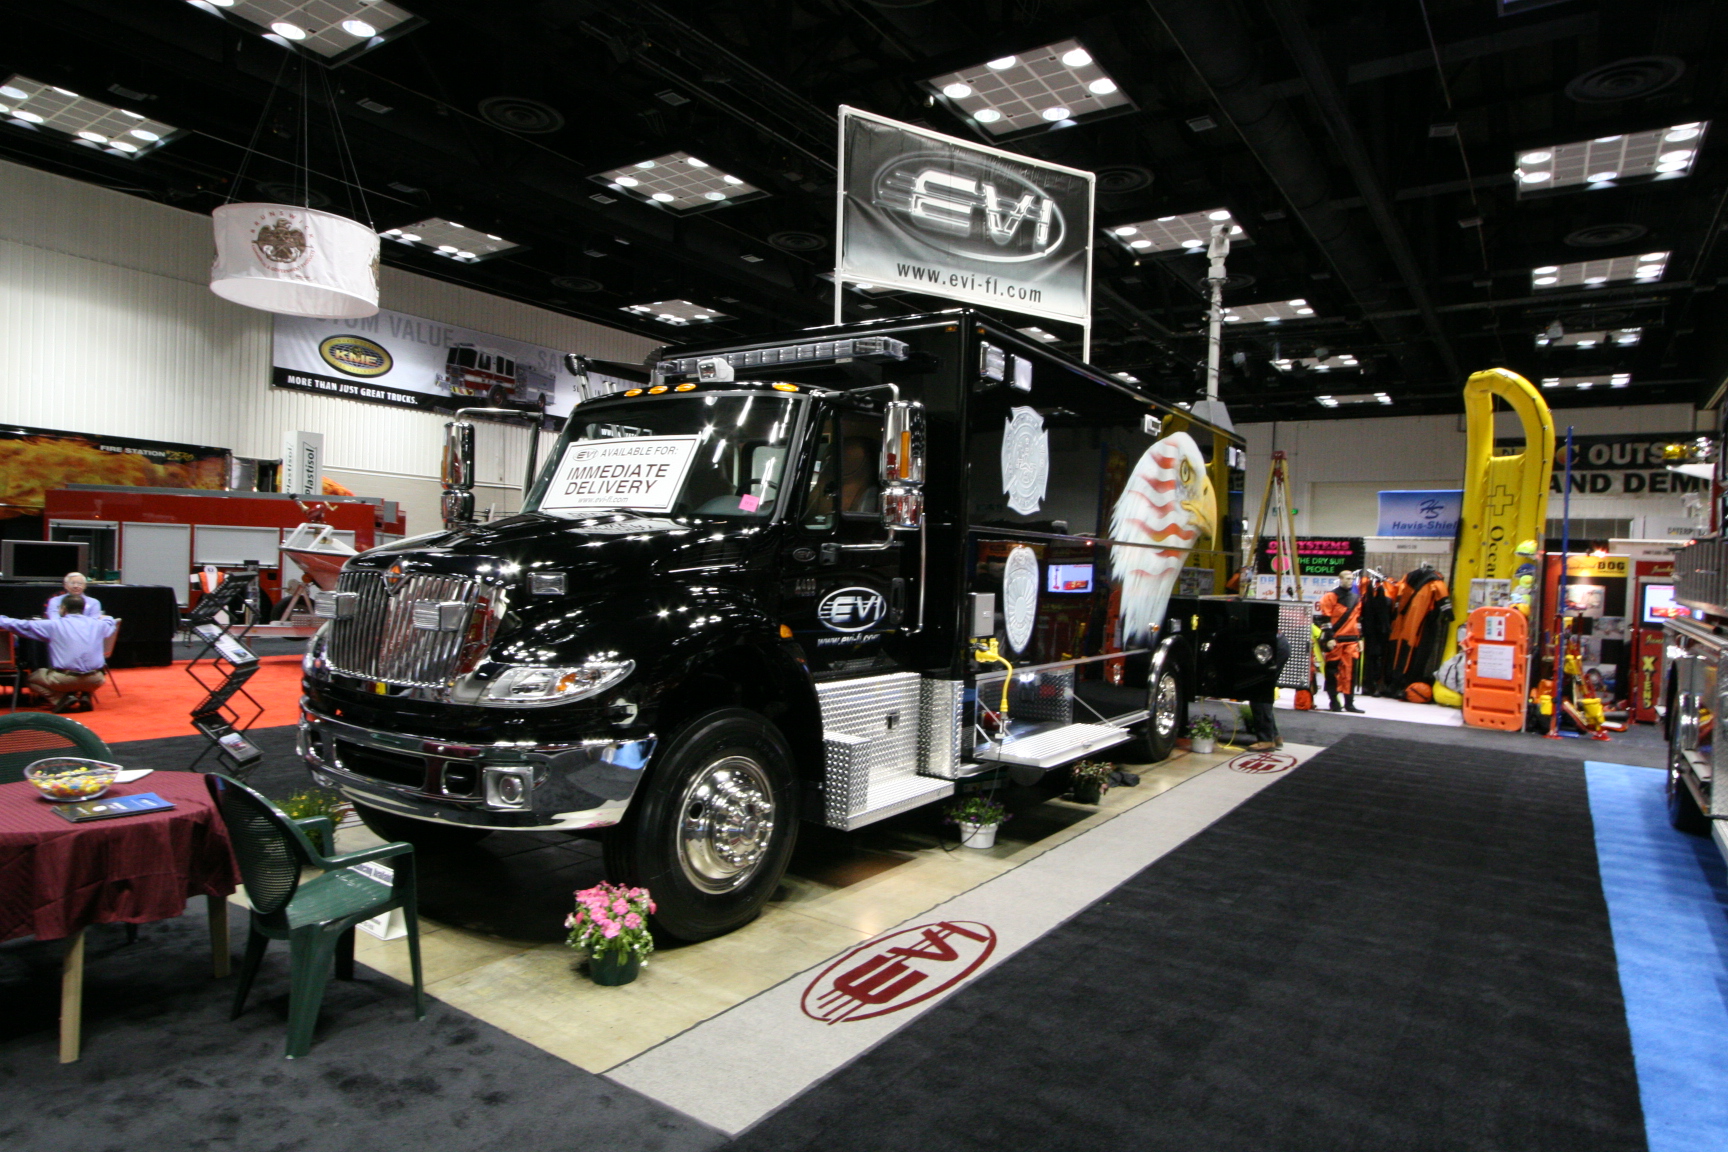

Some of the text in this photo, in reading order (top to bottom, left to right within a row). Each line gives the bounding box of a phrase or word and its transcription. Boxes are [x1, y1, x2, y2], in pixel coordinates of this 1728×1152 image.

[908, 168, 1056, 253] EVI
[896, 262, 1043, 304] www.evi-fl.com
[389, 314, 453, 349] VALUE
[333, 350, 379, 367] KME
[287, 375, 418, 405] MORE THAN JUST GREAT TRUCKS.
[100, 444, 122, 454] FIRE
[124, 447, 166, 458] STATION
[575, 446, 679, 461] EVI AVAILABLE FOR:
[566, 464, 671, 481] IMMEDIATE
[564, 480, 658, 496] DELIVERY
[1391, 520, 1458, 530] Havis-Shiel
[1305, 566, 1335, 574] PEOPLE
[1312, 557, 1328, 566] DRY
[1329, 558, 1346, 567] SUIT
[826, 594, 884, 624] EVI
[824, 920, 992, 1012] EVI
